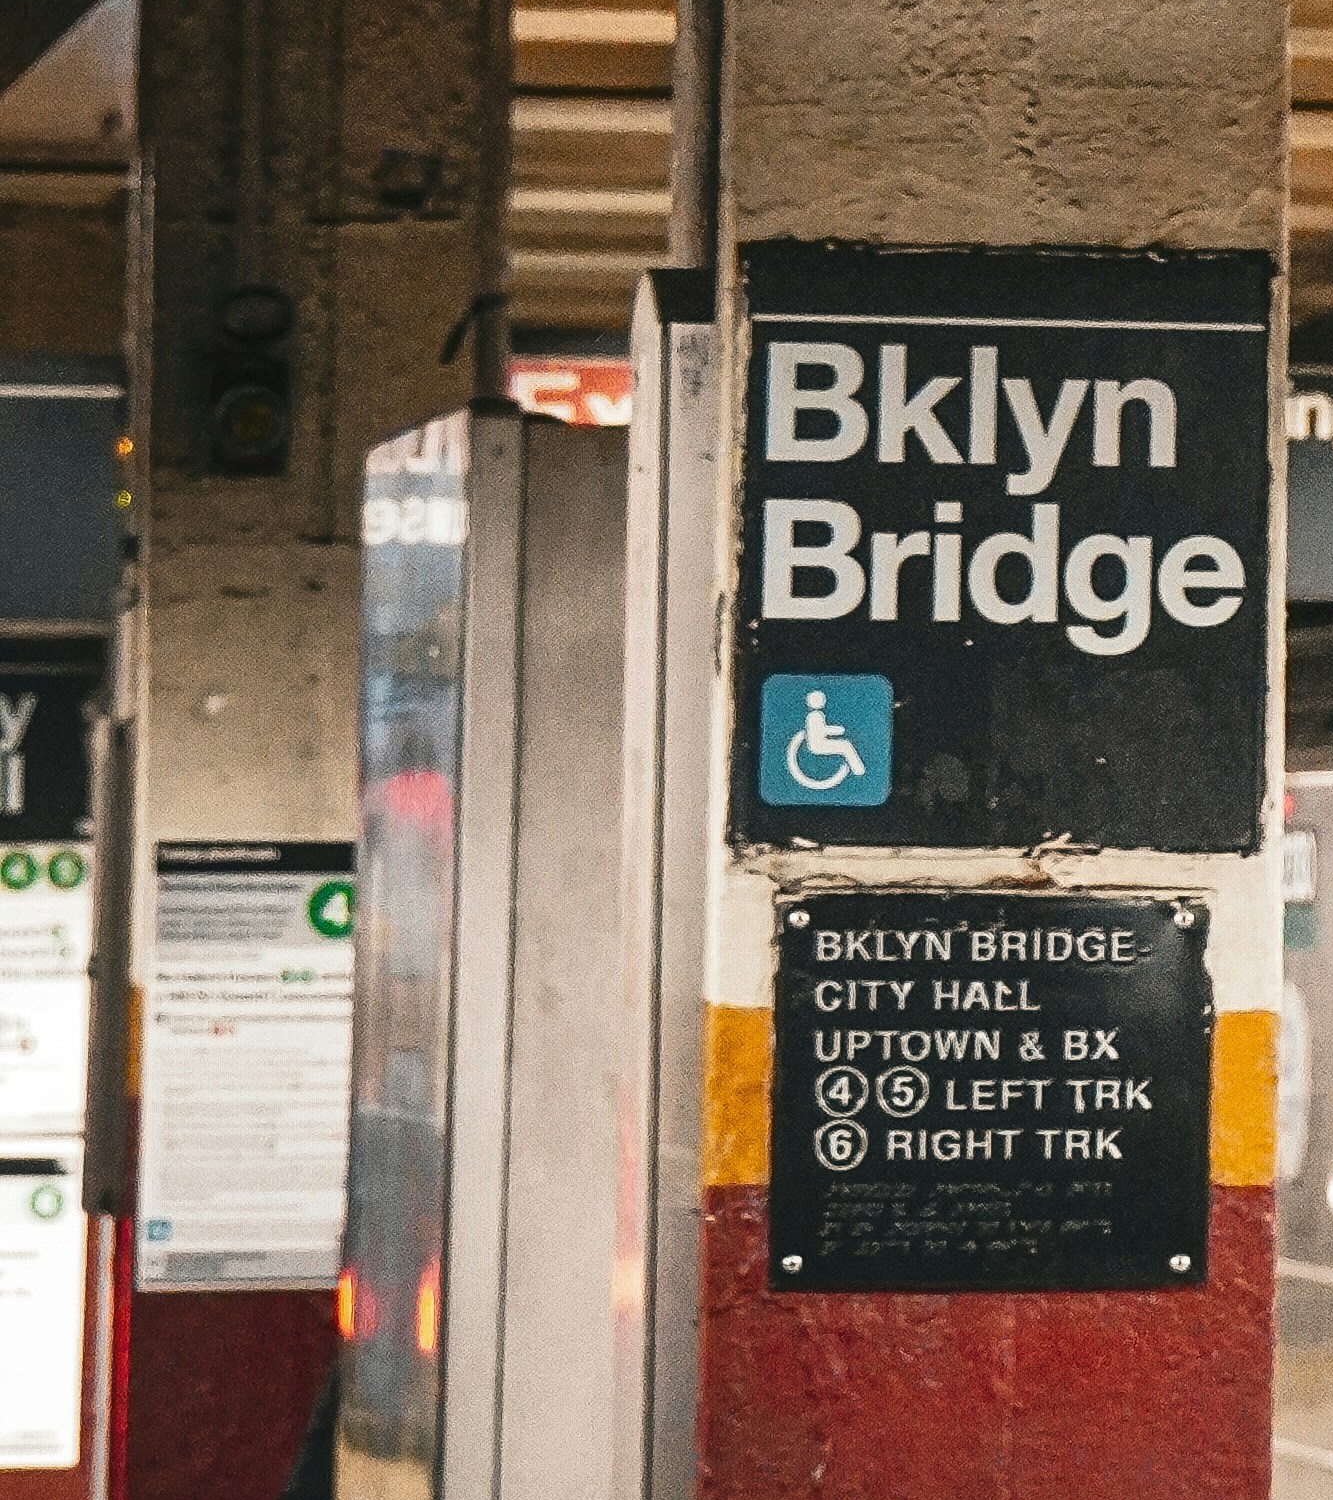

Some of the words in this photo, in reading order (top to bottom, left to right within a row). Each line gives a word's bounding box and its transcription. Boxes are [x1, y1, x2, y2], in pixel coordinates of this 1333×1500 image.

[765, 342, 1177, 495] Bklyn
[761, 498, 1245, 656] Bridge
[814, 930, 952, 963] BKLYN
[814, 979, 915, 1013] CITY
[932, 979, 1041, 1012] HALL
[814, 1029, 1000, 1063] UPTOWN
[1018, 1030, 1047, 1062] &
[1063, 1027, 1120, 1062] BX
[945, 1078, 1056, 1112] LEFT
[1066, 1077, 1153, 1114] TRK
[886, 1128, 1024, 1162] RIGHT
[1036, 1127, 1123, 1161] TRK
